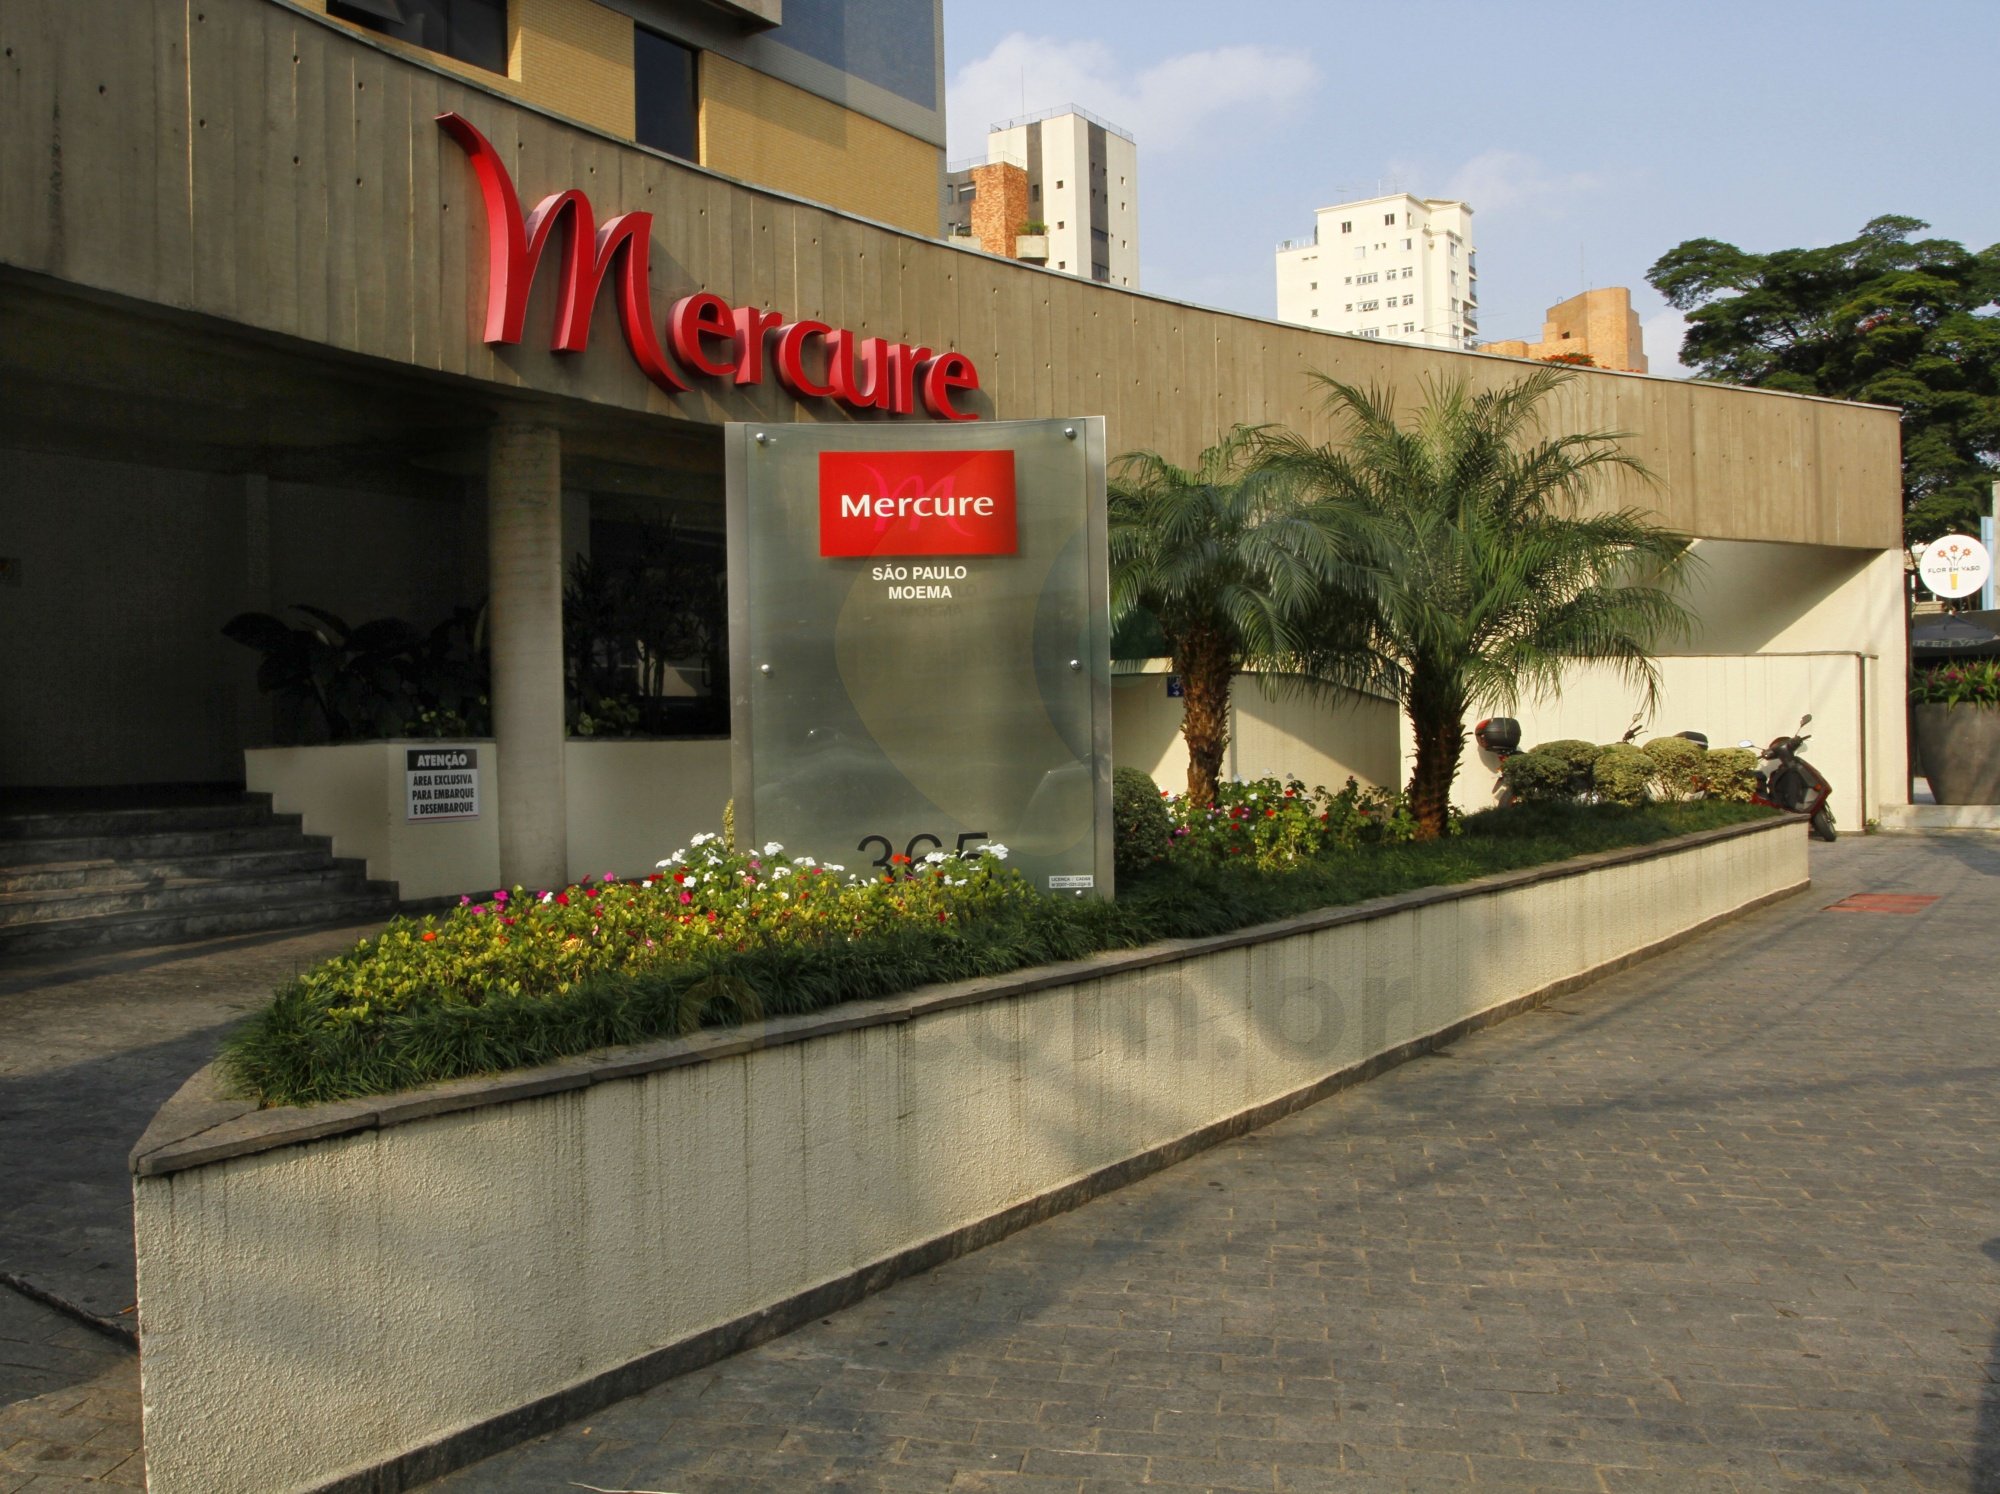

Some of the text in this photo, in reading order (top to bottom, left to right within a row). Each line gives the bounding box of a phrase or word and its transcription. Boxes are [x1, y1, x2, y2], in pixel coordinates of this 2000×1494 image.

[433, 111, 980, 420] Mercure
[840, 494, 994, 518] Mercure
[872, 564, 968, 581] SÃO PAULO
[888, 585, 953, 600] MOEMA
[417, 751, 468, 769] ATENÇÃO
[413, 773, 473, 786] ÁREA EXCLUSIVA
[412, 788, 474, 801] PARA EMBARQUE
[413, 802, 474, 815] E DESEMBARQUE
